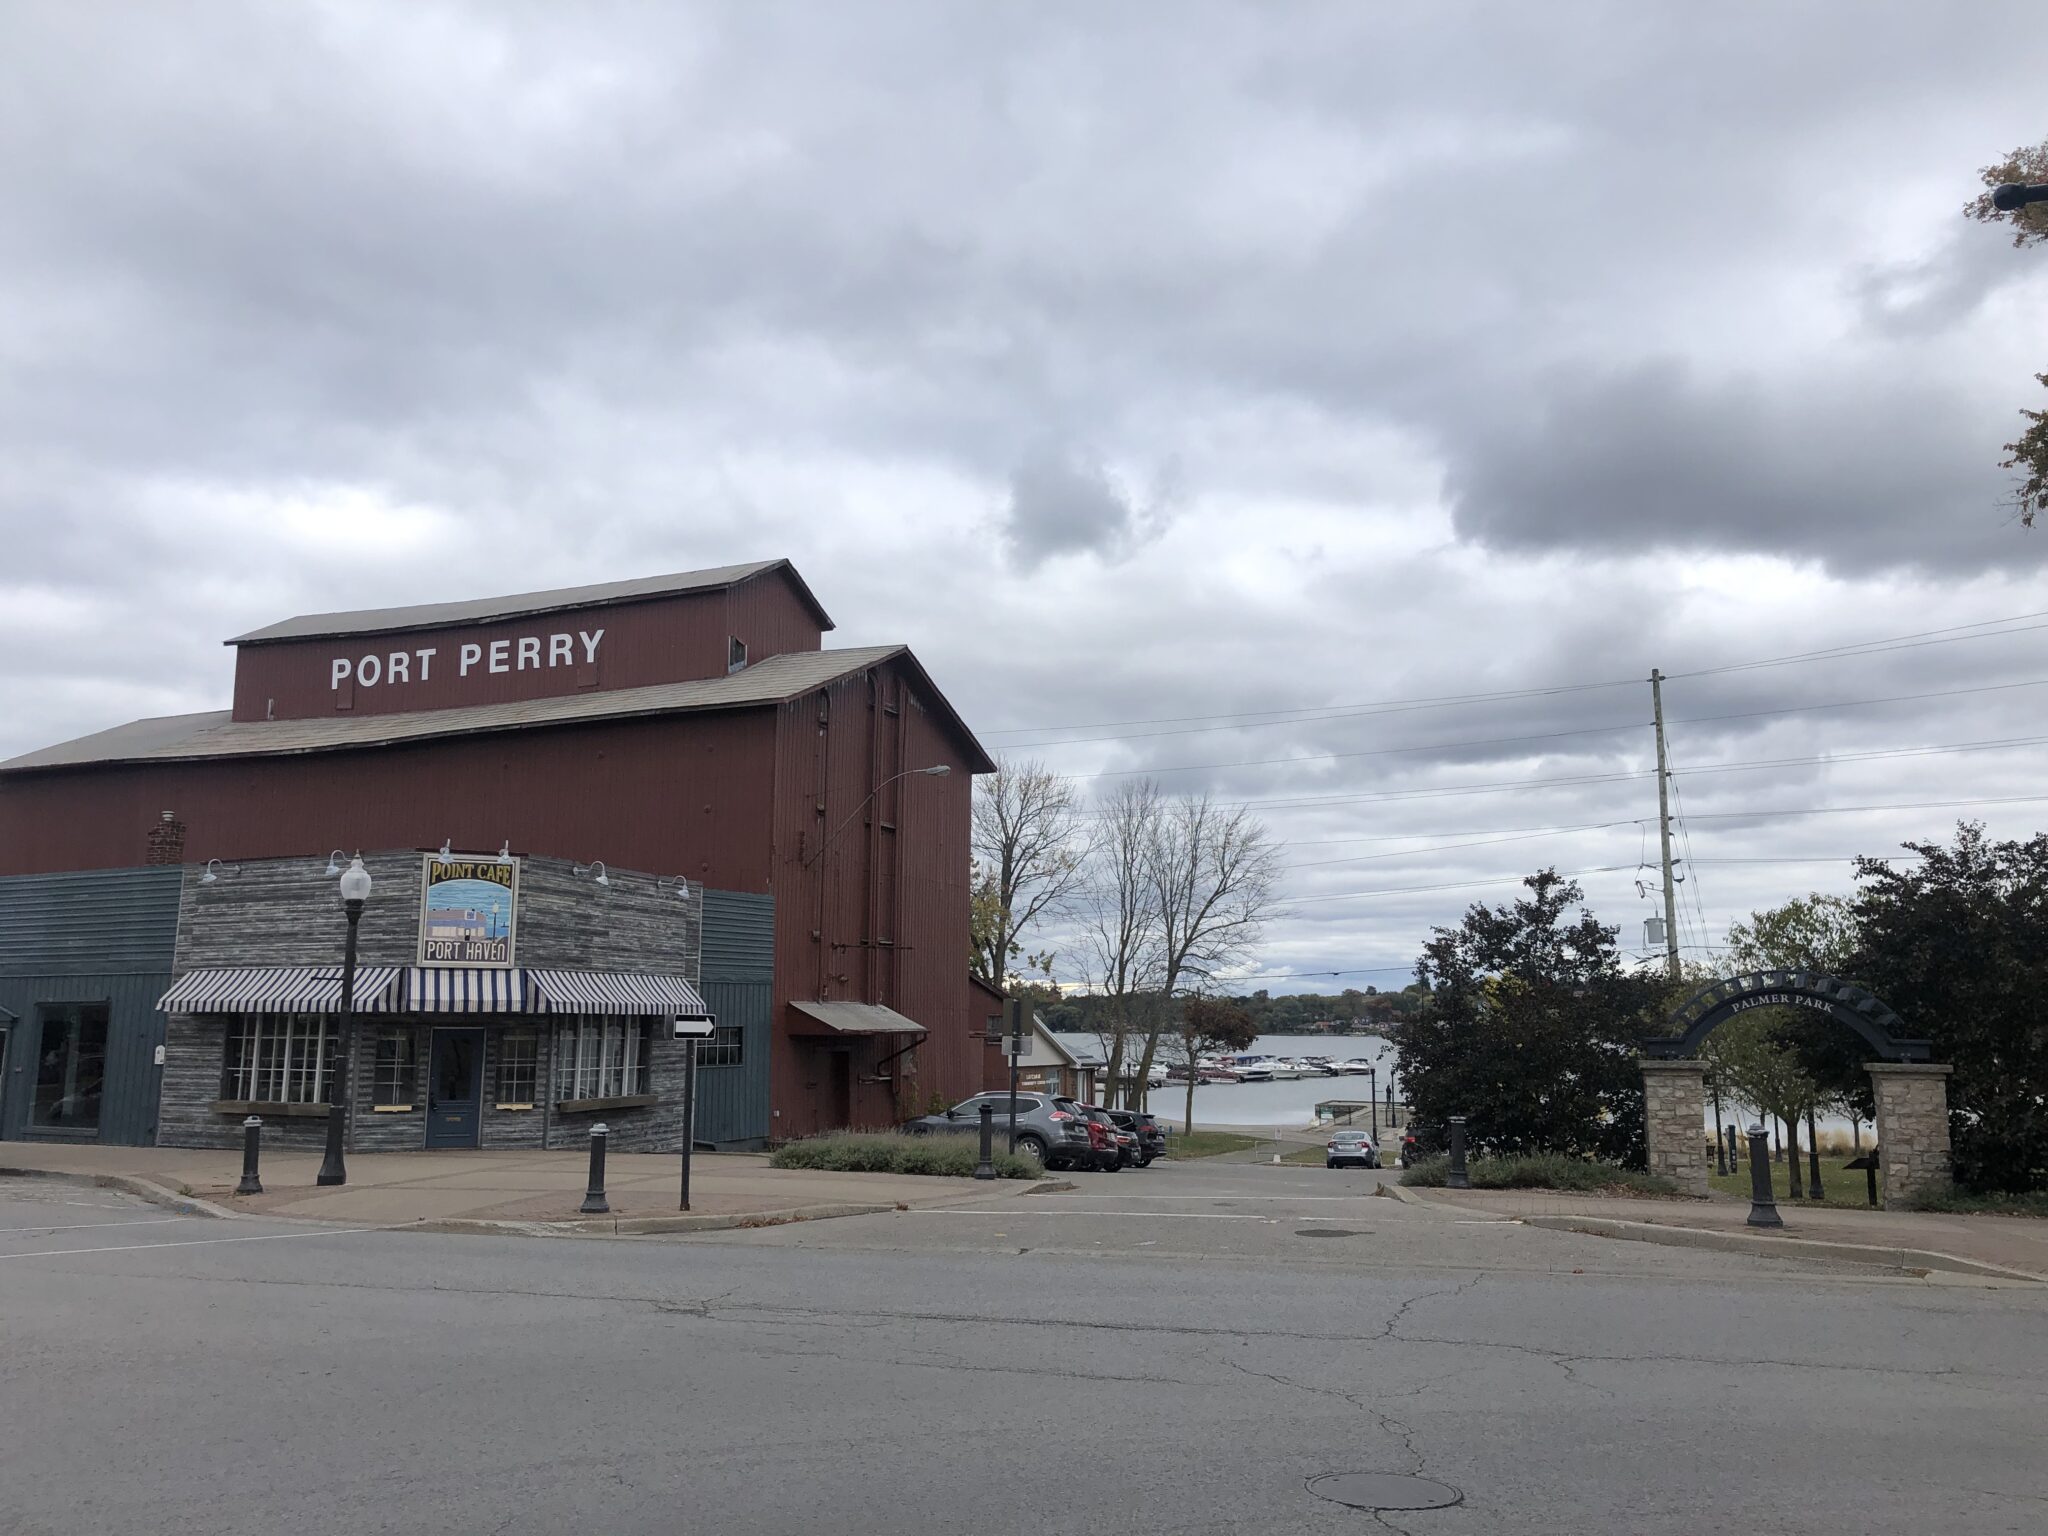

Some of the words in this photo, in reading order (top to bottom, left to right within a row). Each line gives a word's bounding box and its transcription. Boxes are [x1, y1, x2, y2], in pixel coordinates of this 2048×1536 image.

[331, 648, 437, 690] PORT
[460, 629, 605, 677] PERRY
[431, 863, 474, 883] POINT
[477, 865, 511, 887] CAFE
[427, 941, 460, 959] PORT
[466, 943, 505, 960] HAVEN
[1731, 994, 1790, 1013] PALMER
[1795, 995, 1835, 1013] PARK
